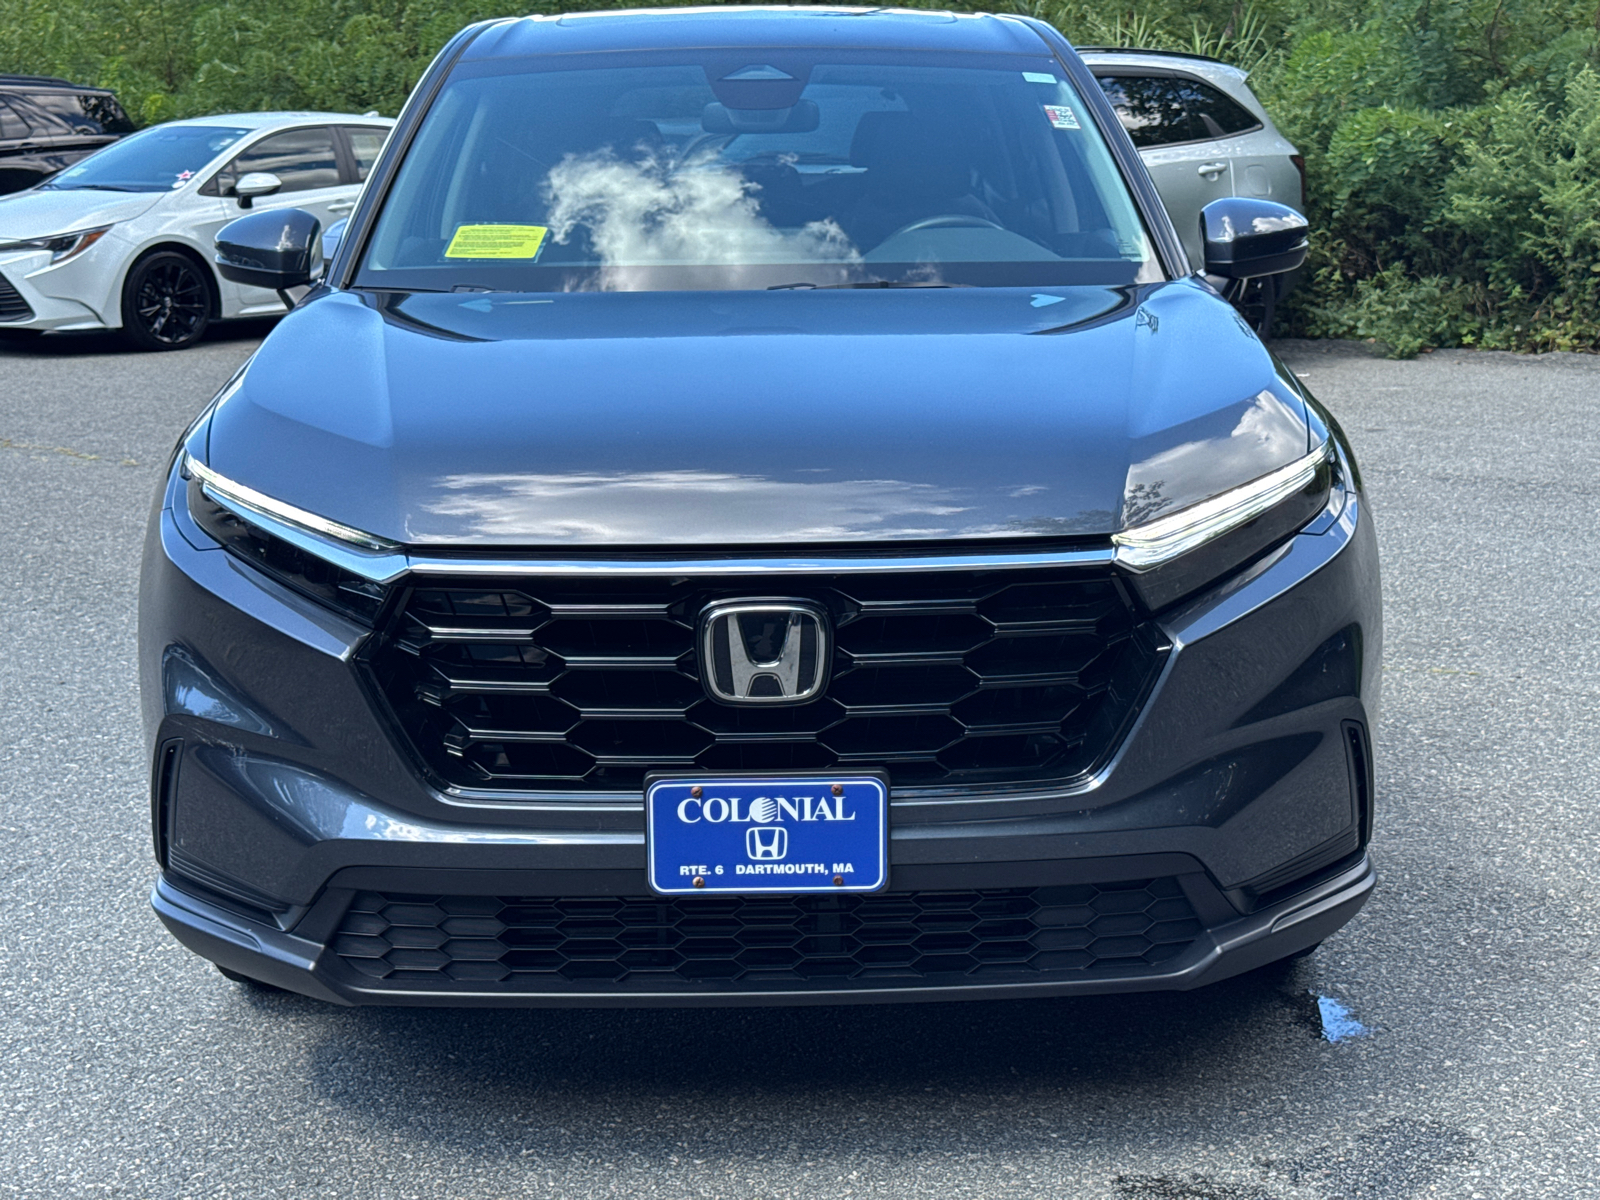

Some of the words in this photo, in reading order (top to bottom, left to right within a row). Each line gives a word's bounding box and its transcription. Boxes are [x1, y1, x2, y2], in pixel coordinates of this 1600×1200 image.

[677, 796, 856, 824] COLONIAL
[679, 865, 712, 876] RTE.
[714, 865, 724, 875] 6
[735, 863, 829, 876] DARTMOUTH,
[832, 862, 855, 874] MA
